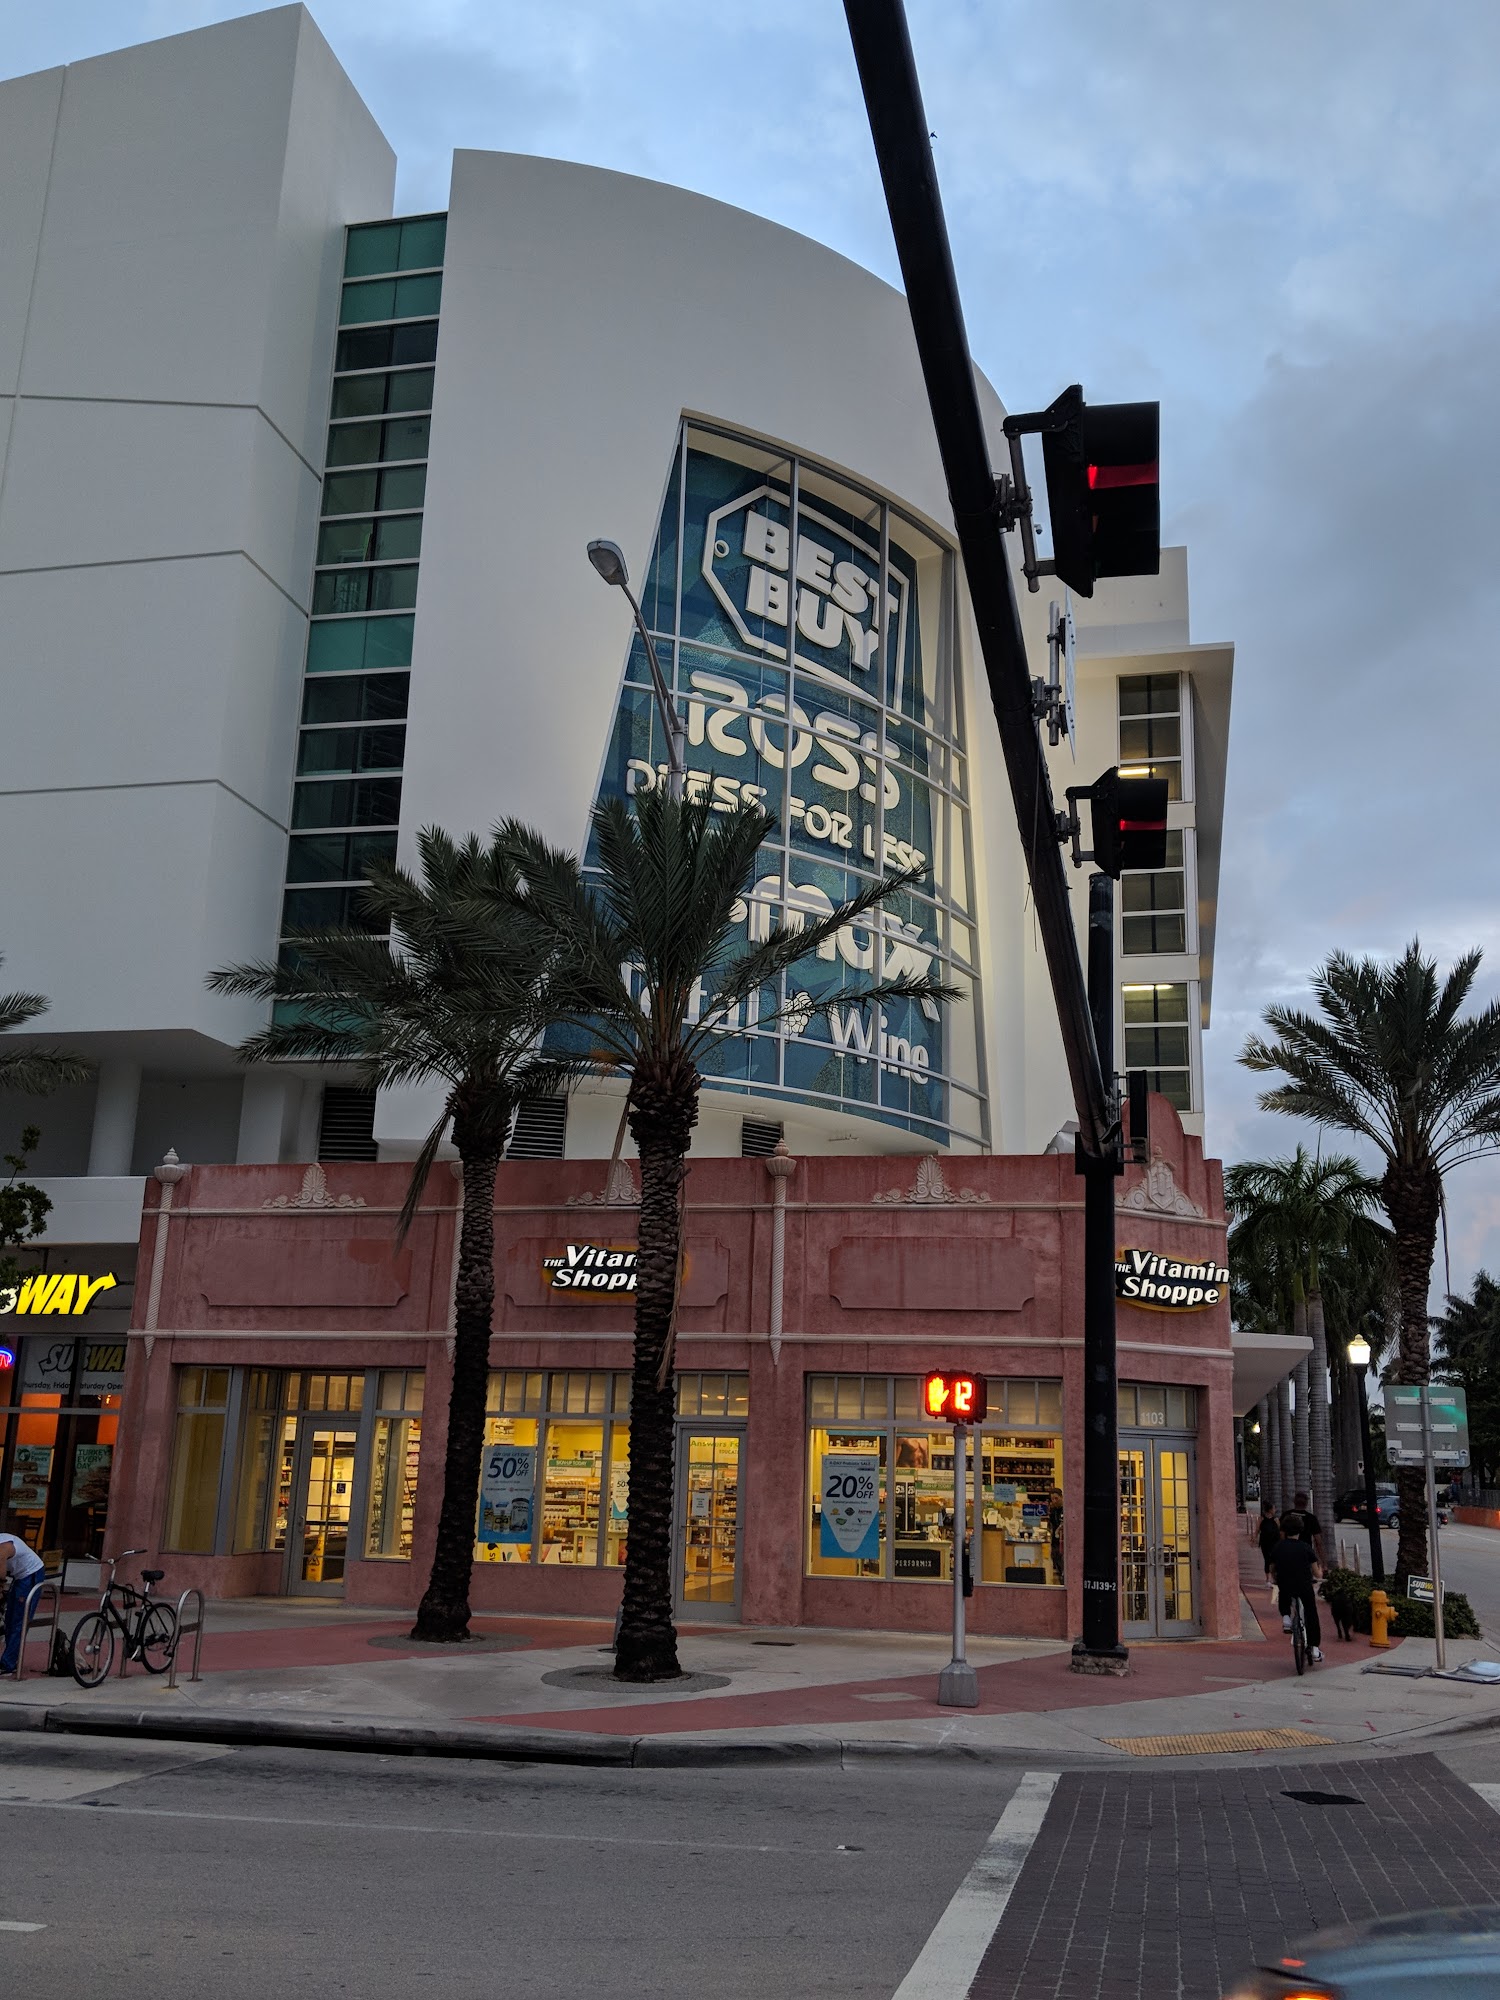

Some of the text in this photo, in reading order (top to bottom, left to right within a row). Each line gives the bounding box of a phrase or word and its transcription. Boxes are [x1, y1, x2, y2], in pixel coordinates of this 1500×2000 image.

[742, 507, 899, 629] BEST
[746, 564, 879, 671] BUY
[687, 671, 901, 810] ROSS
[789, 797, 852, 849] FOR
[863, 824, 926, 881] LESS
[826, 1002, 930, 1085] Wine
[544, 1245, 638, 1268] THE Vita
[1114, 1250, 1230, 1282] THE Vitamin
[551, 1268, 639, 1291] Shopp
[1121, 1276, 1220, 1306] Shoppe
[38, 1343, 128, 1376] SUWA
[23, 1382, 51, 1390] hursday,
[53, 1381, 71, 1389] Frida
[954, 1381, 974, 1411] 12
[1140, 1412, 1164, 1425] 1103
[487, 1457, 530, 1479] 50%
[516, 1469, 529, 1477] OFF
[826, 1475, 874, 1499] 20%
[856, 1490, 874, 1499] OFF
[895, 1559, 932, 1568] PERFORMIX
